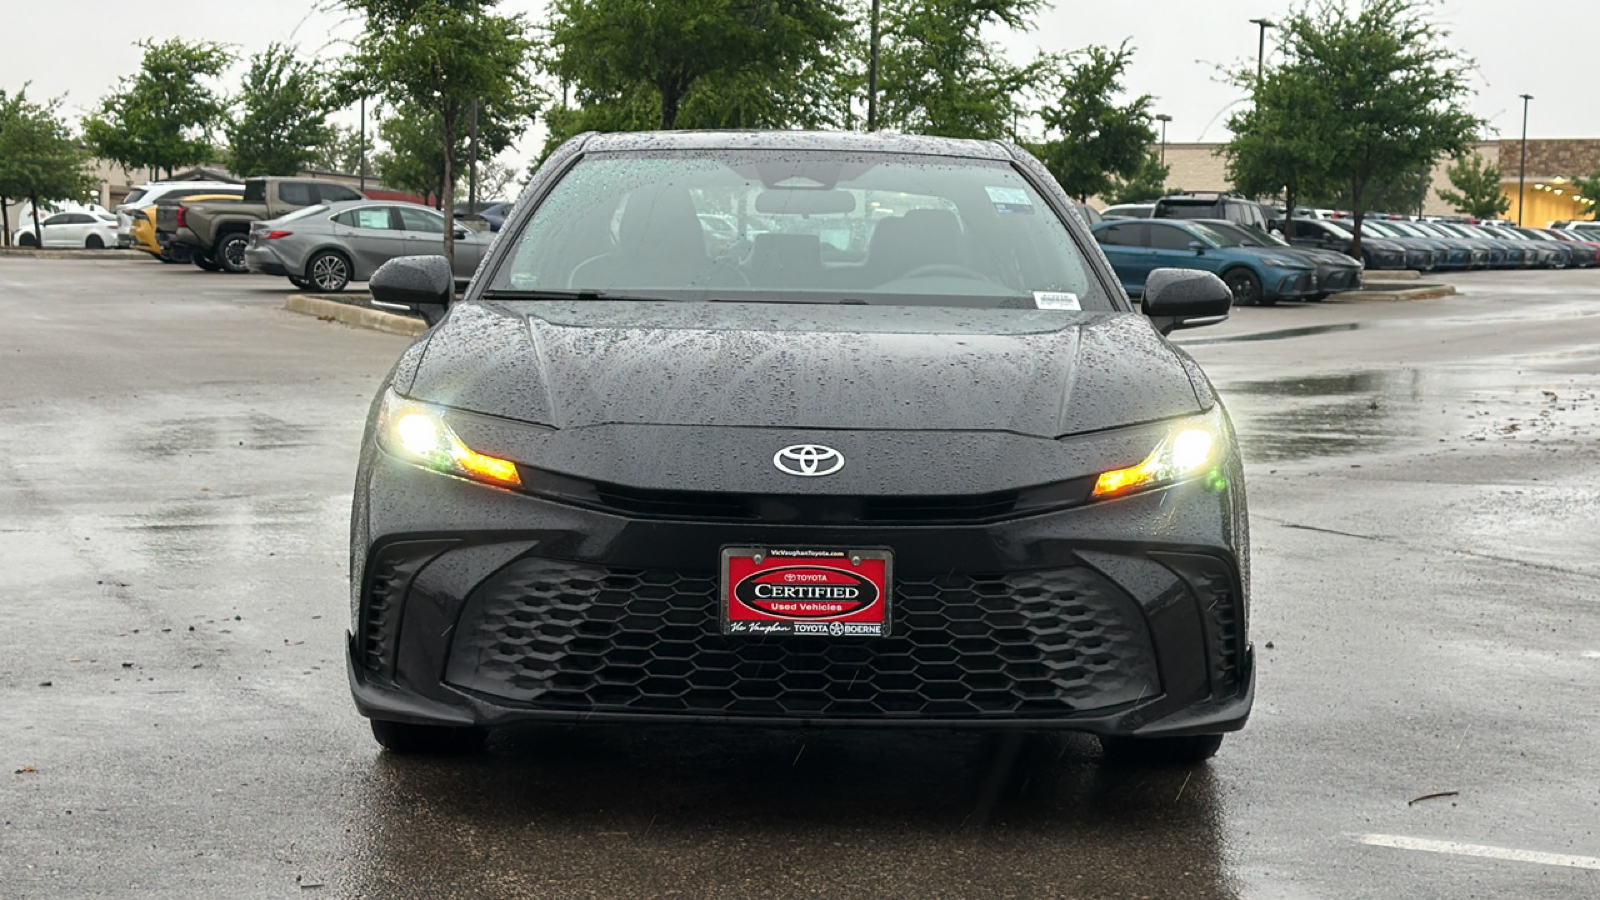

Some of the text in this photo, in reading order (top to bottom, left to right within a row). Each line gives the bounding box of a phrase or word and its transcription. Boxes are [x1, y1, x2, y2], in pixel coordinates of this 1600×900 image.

[770, 549, 845, 557] VicVaughanToyota.com
[796, 574, 827, 582] TOYOTA
[754, 584, 860, 599] CERTIFIED
[771, 603, 842, 611] Used Vehicles
[794, 624, 829, 633] TOYOTA
[845, 625, 881, 633] BOERNE
